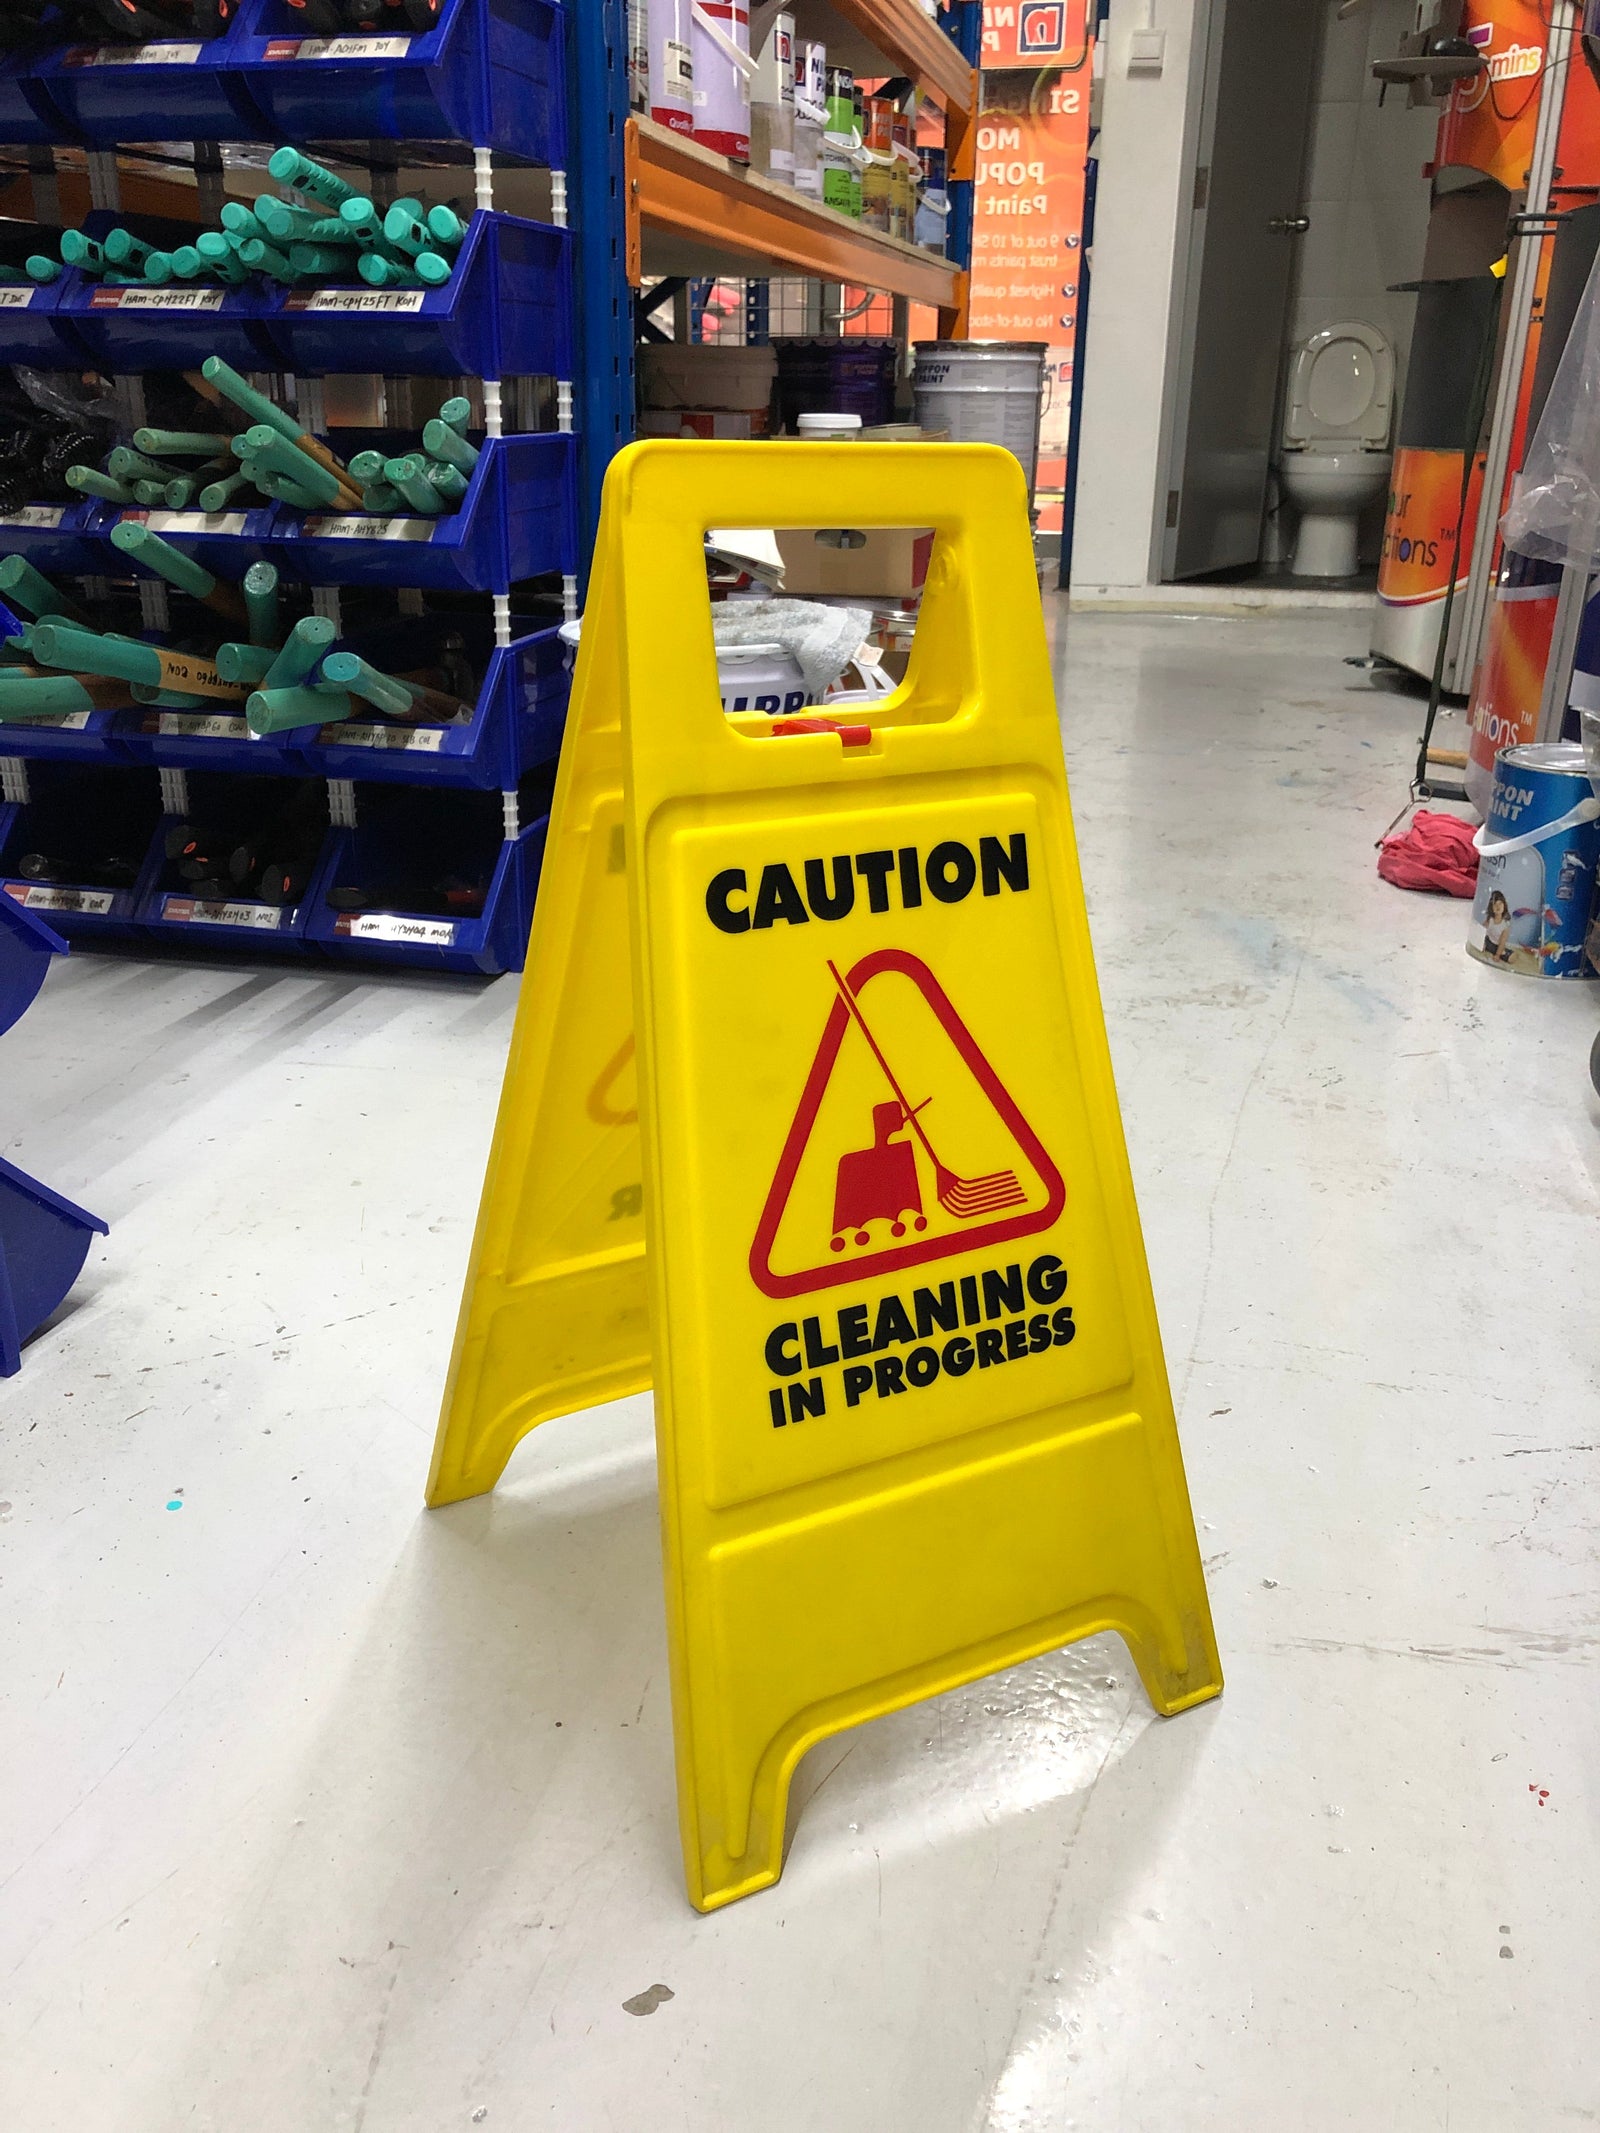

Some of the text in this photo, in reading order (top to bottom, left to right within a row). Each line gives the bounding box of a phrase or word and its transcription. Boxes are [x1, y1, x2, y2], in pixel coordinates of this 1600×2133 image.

[1491, 46, 1539, 78] mins
[705, 833, 1030, 934] CAUTION
[764, 1254, 1069, 1377] CLEANING
[768, 1306, 1077, 1429] IN PROGRESS
